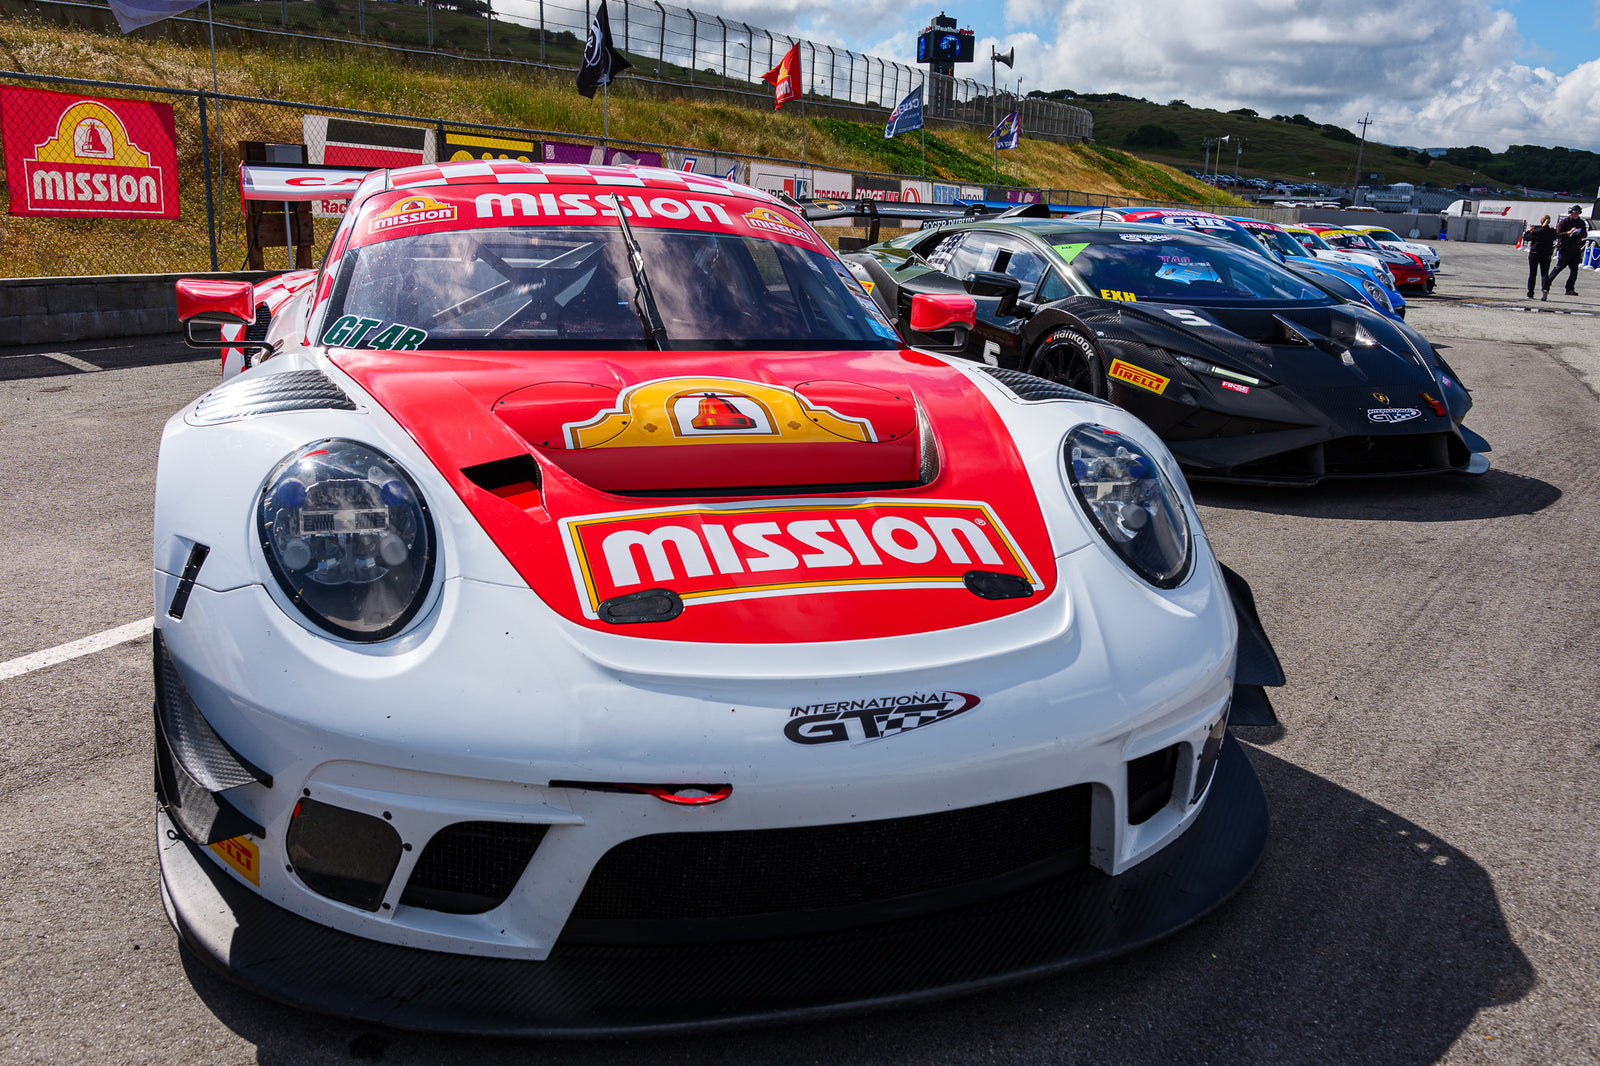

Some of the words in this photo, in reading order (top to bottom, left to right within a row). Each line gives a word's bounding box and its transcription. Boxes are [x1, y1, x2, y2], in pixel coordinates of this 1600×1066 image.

[33, 170, 157, 203] MISSION
[374, 210, 451, 230] MISSION
[476, 192, 733, 226] MISSION
[750, 217, 810, 242] MISSION
[1101, 289, 1137, 302] EXH
[322, 314, 383, 348] GT
[368, 323, 428, 350] 4R
[1112, 361, 1165, 391] PIRELLI
[602, 516, 1003, 587] MISSION
[790, 691, 954, 718] INTERNATIONAL
[783, 707, 894, 745] GT
